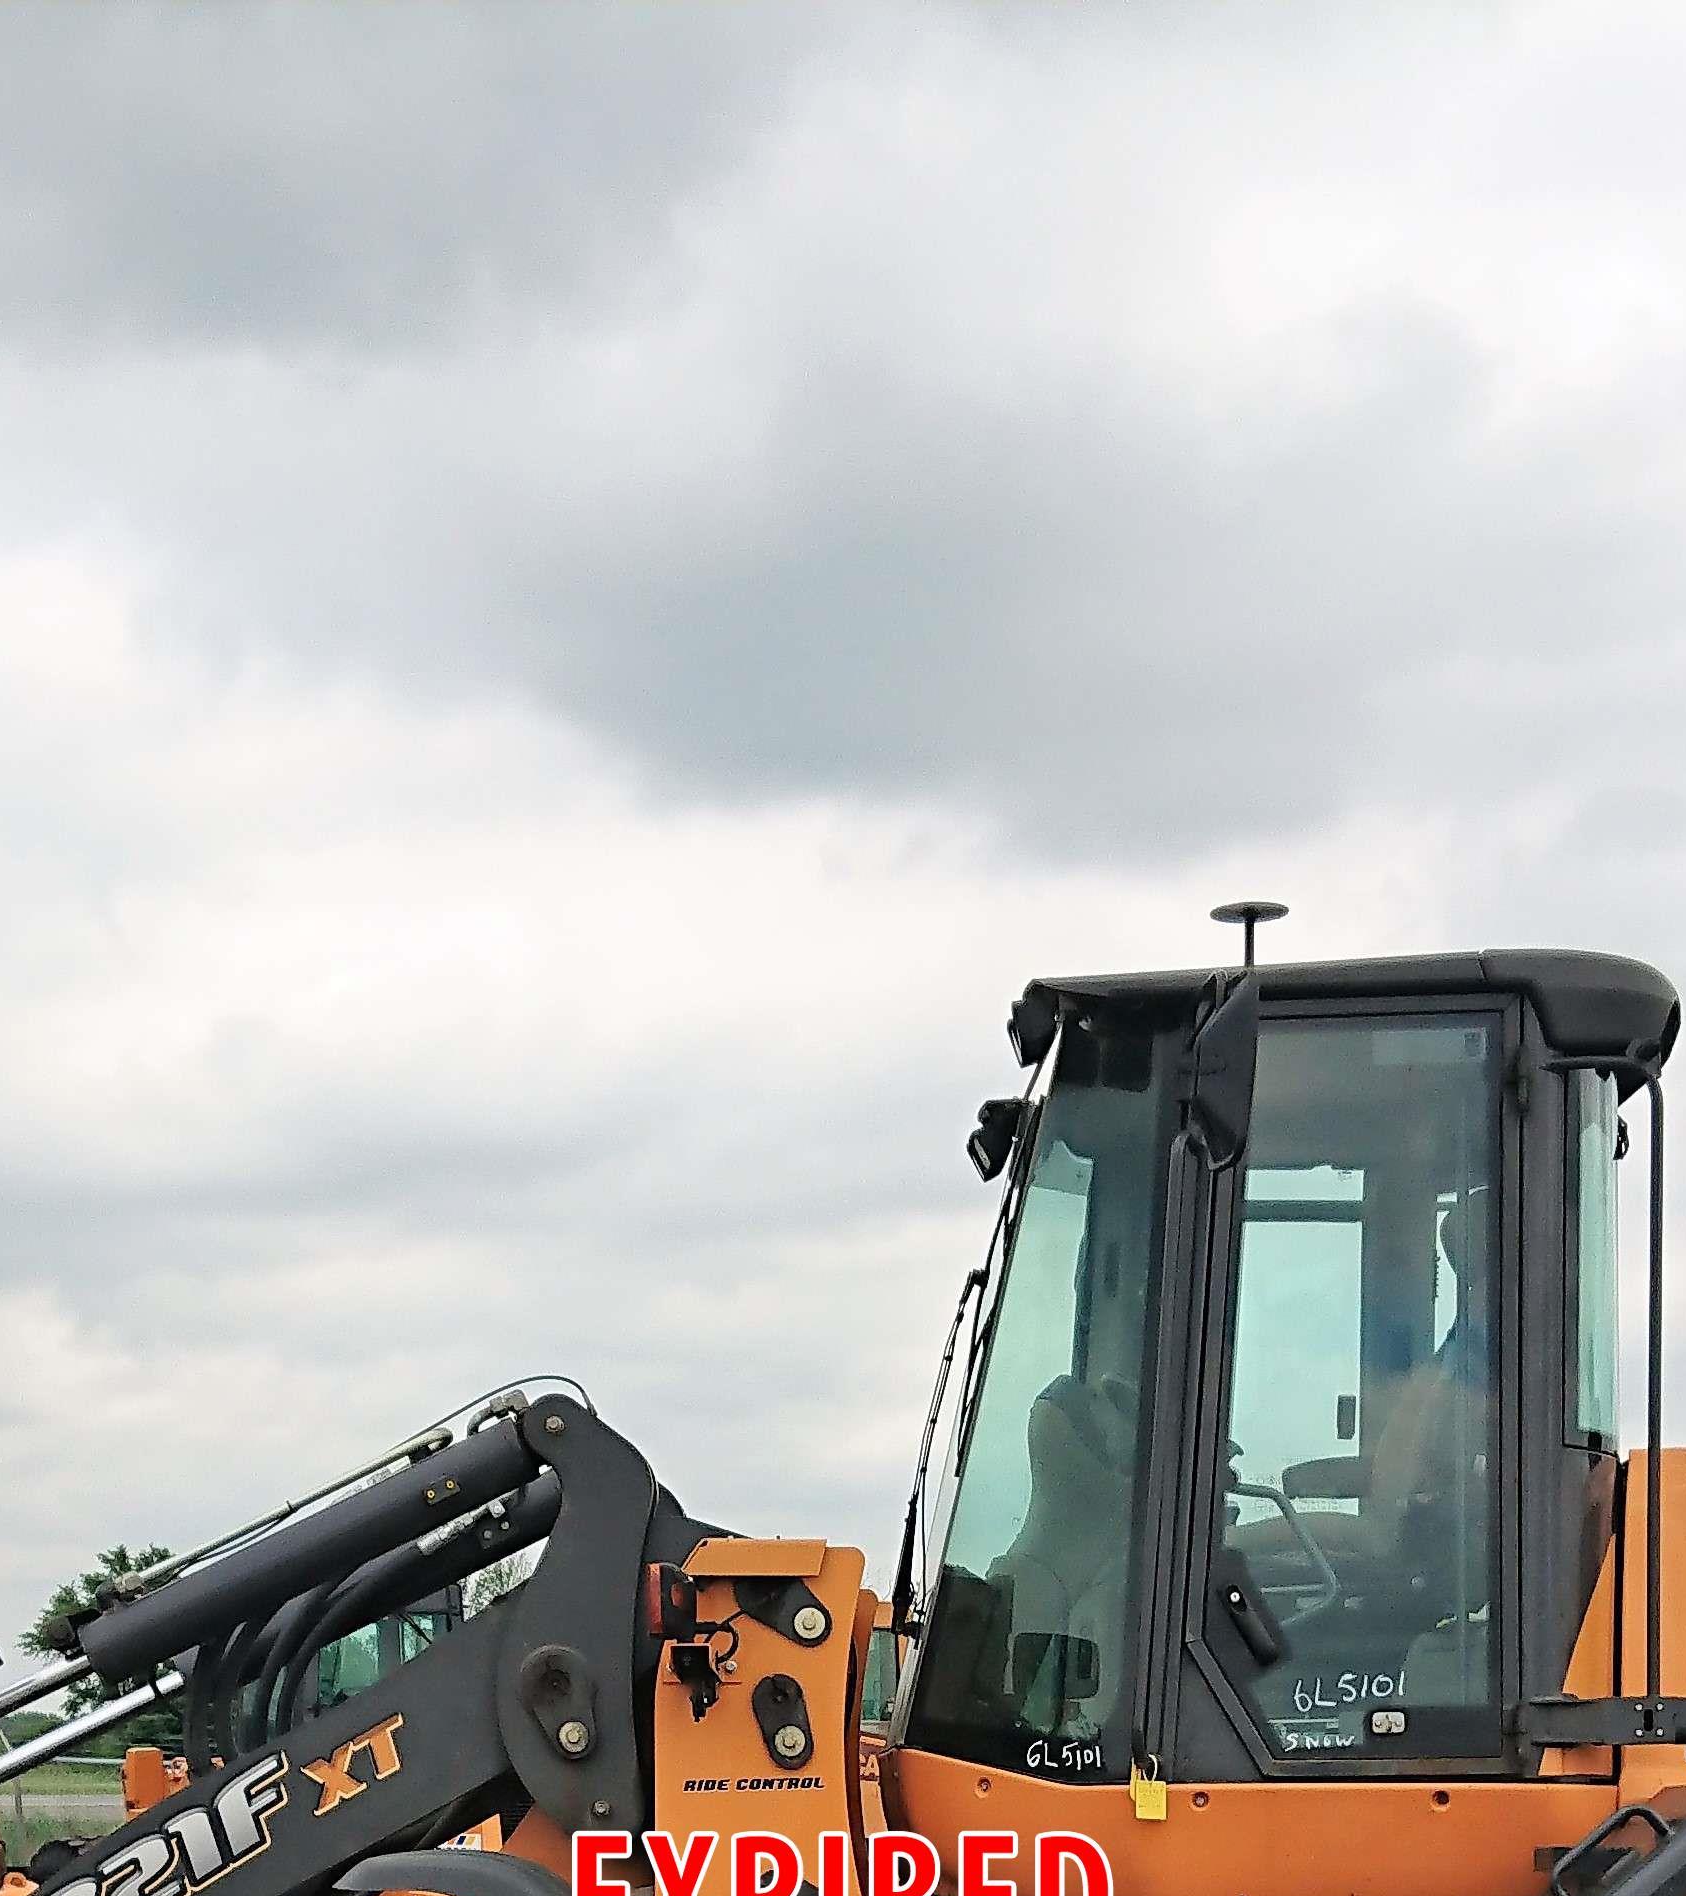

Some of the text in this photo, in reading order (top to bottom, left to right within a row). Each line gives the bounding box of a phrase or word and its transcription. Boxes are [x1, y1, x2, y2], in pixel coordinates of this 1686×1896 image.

[1292, 1671, 1405, 1713] 6L5101
[1285, 1732, 1355, 1753] SNOW
[300, 1712, 404, 1816] XT
[683, 1776, 826, 1793] RIDE CONTROL
